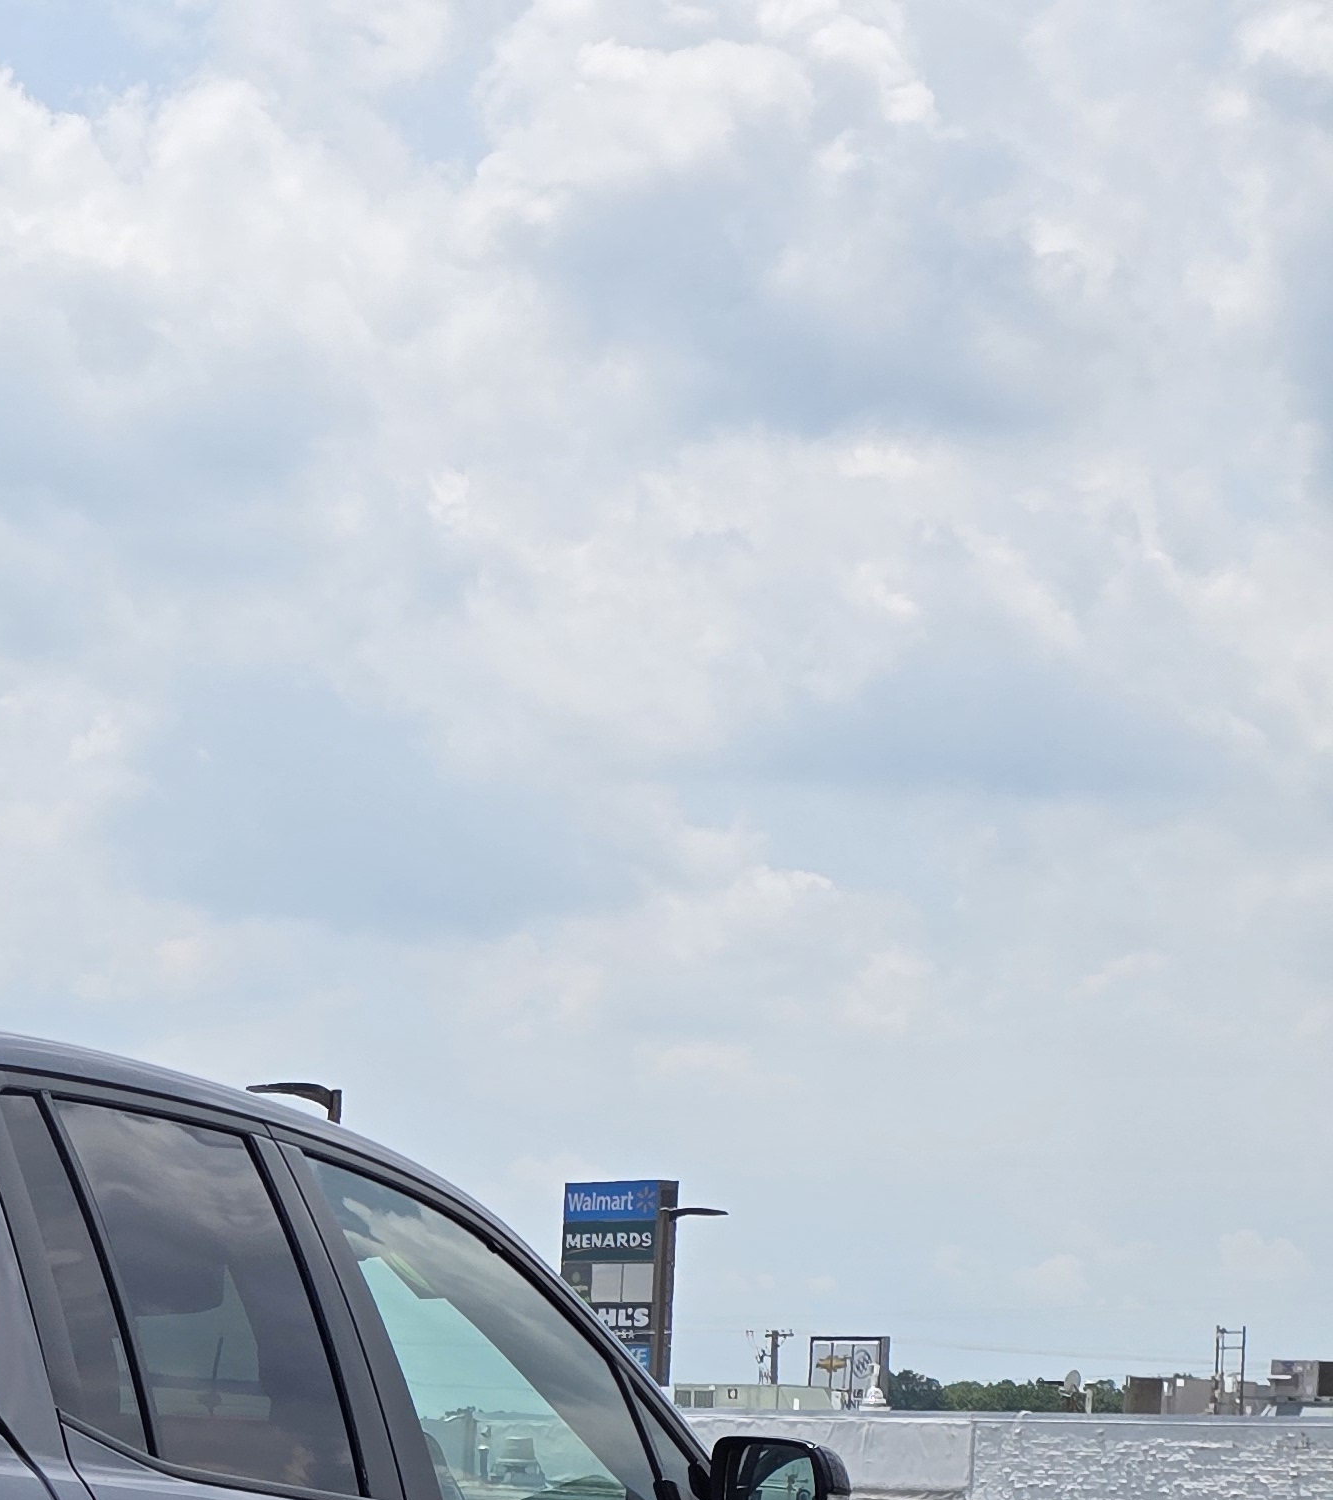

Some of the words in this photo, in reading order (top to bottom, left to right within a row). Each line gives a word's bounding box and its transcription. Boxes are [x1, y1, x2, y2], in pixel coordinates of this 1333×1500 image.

[567, 1191, 634, 1212] Walmart
[565, 1232, 652, 1249] MENARDS
[597, 1308, 649, 1327] HL'S
